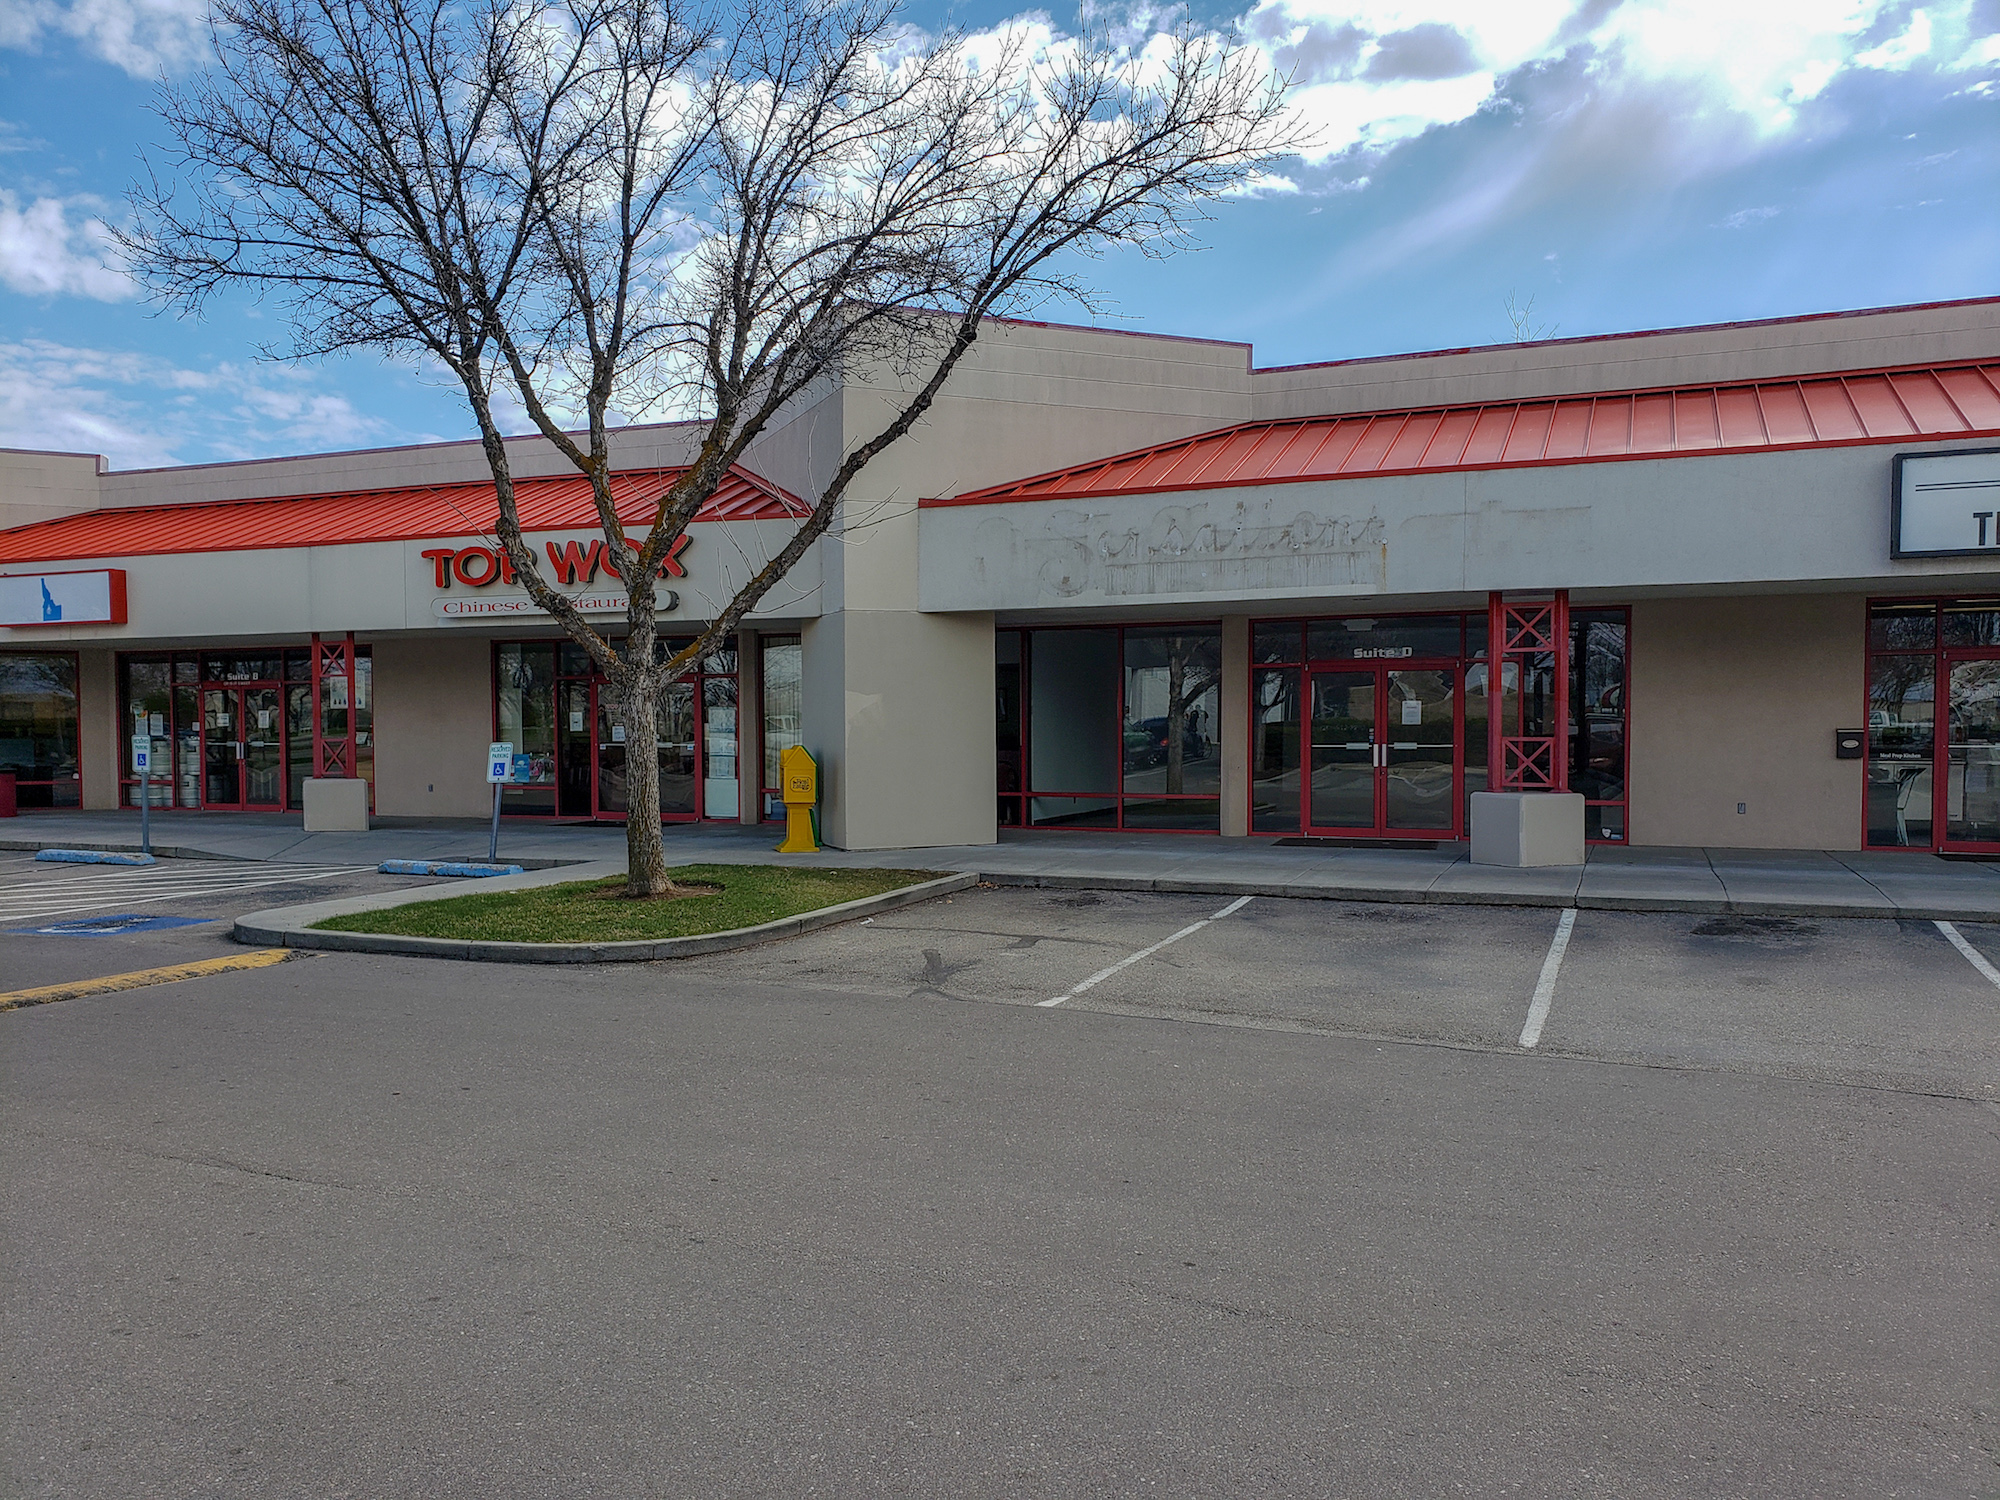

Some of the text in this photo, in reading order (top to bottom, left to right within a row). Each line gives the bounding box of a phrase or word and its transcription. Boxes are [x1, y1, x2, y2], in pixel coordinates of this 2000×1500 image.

[443, 600, 529, 614] Chinese
[1353, 647, 1412, 658] Suite D
[227, 672, 250, 680] Suite
